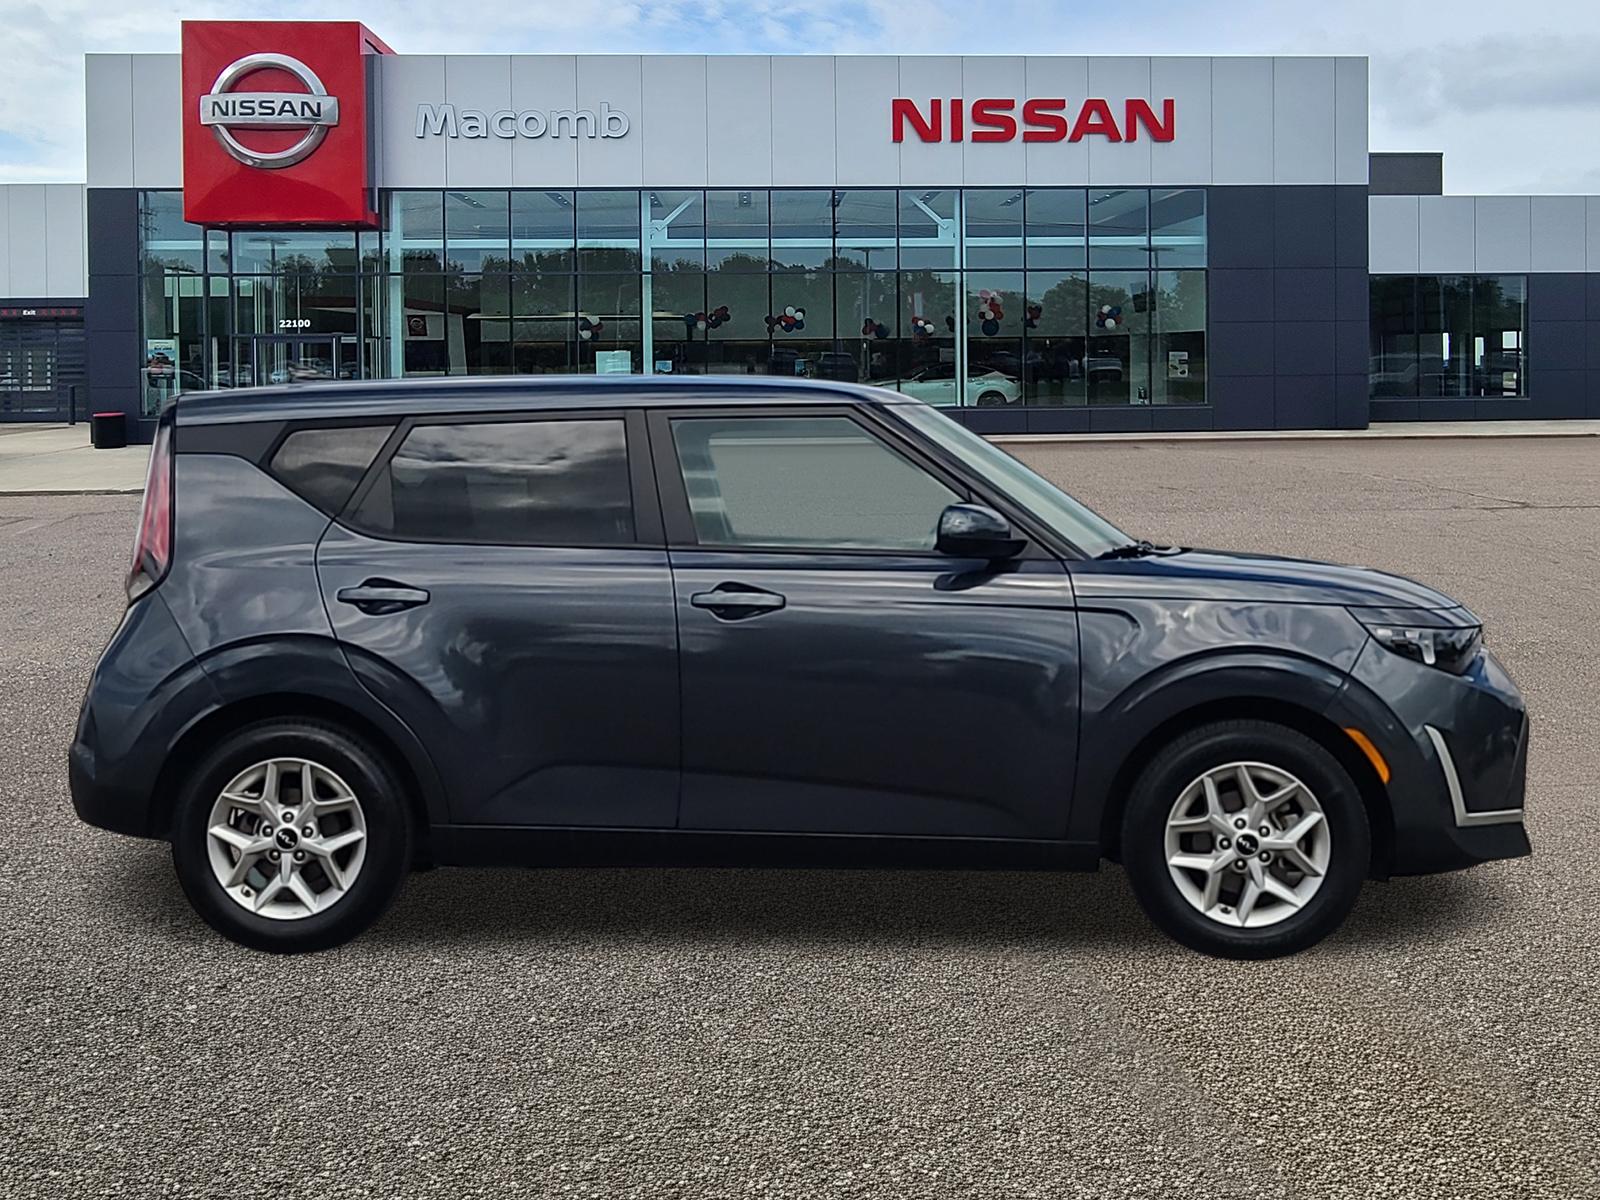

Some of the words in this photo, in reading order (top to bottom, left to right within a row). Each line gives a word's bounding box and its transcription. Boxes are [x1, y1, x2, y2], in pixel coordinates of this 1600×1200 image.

[212, 100, 322, 118] NISSAN
[415, 101, 630, 138] Macomb
[892, 98, 1175, 143] NISSAN
[279, 319, 311, 328] 22100
